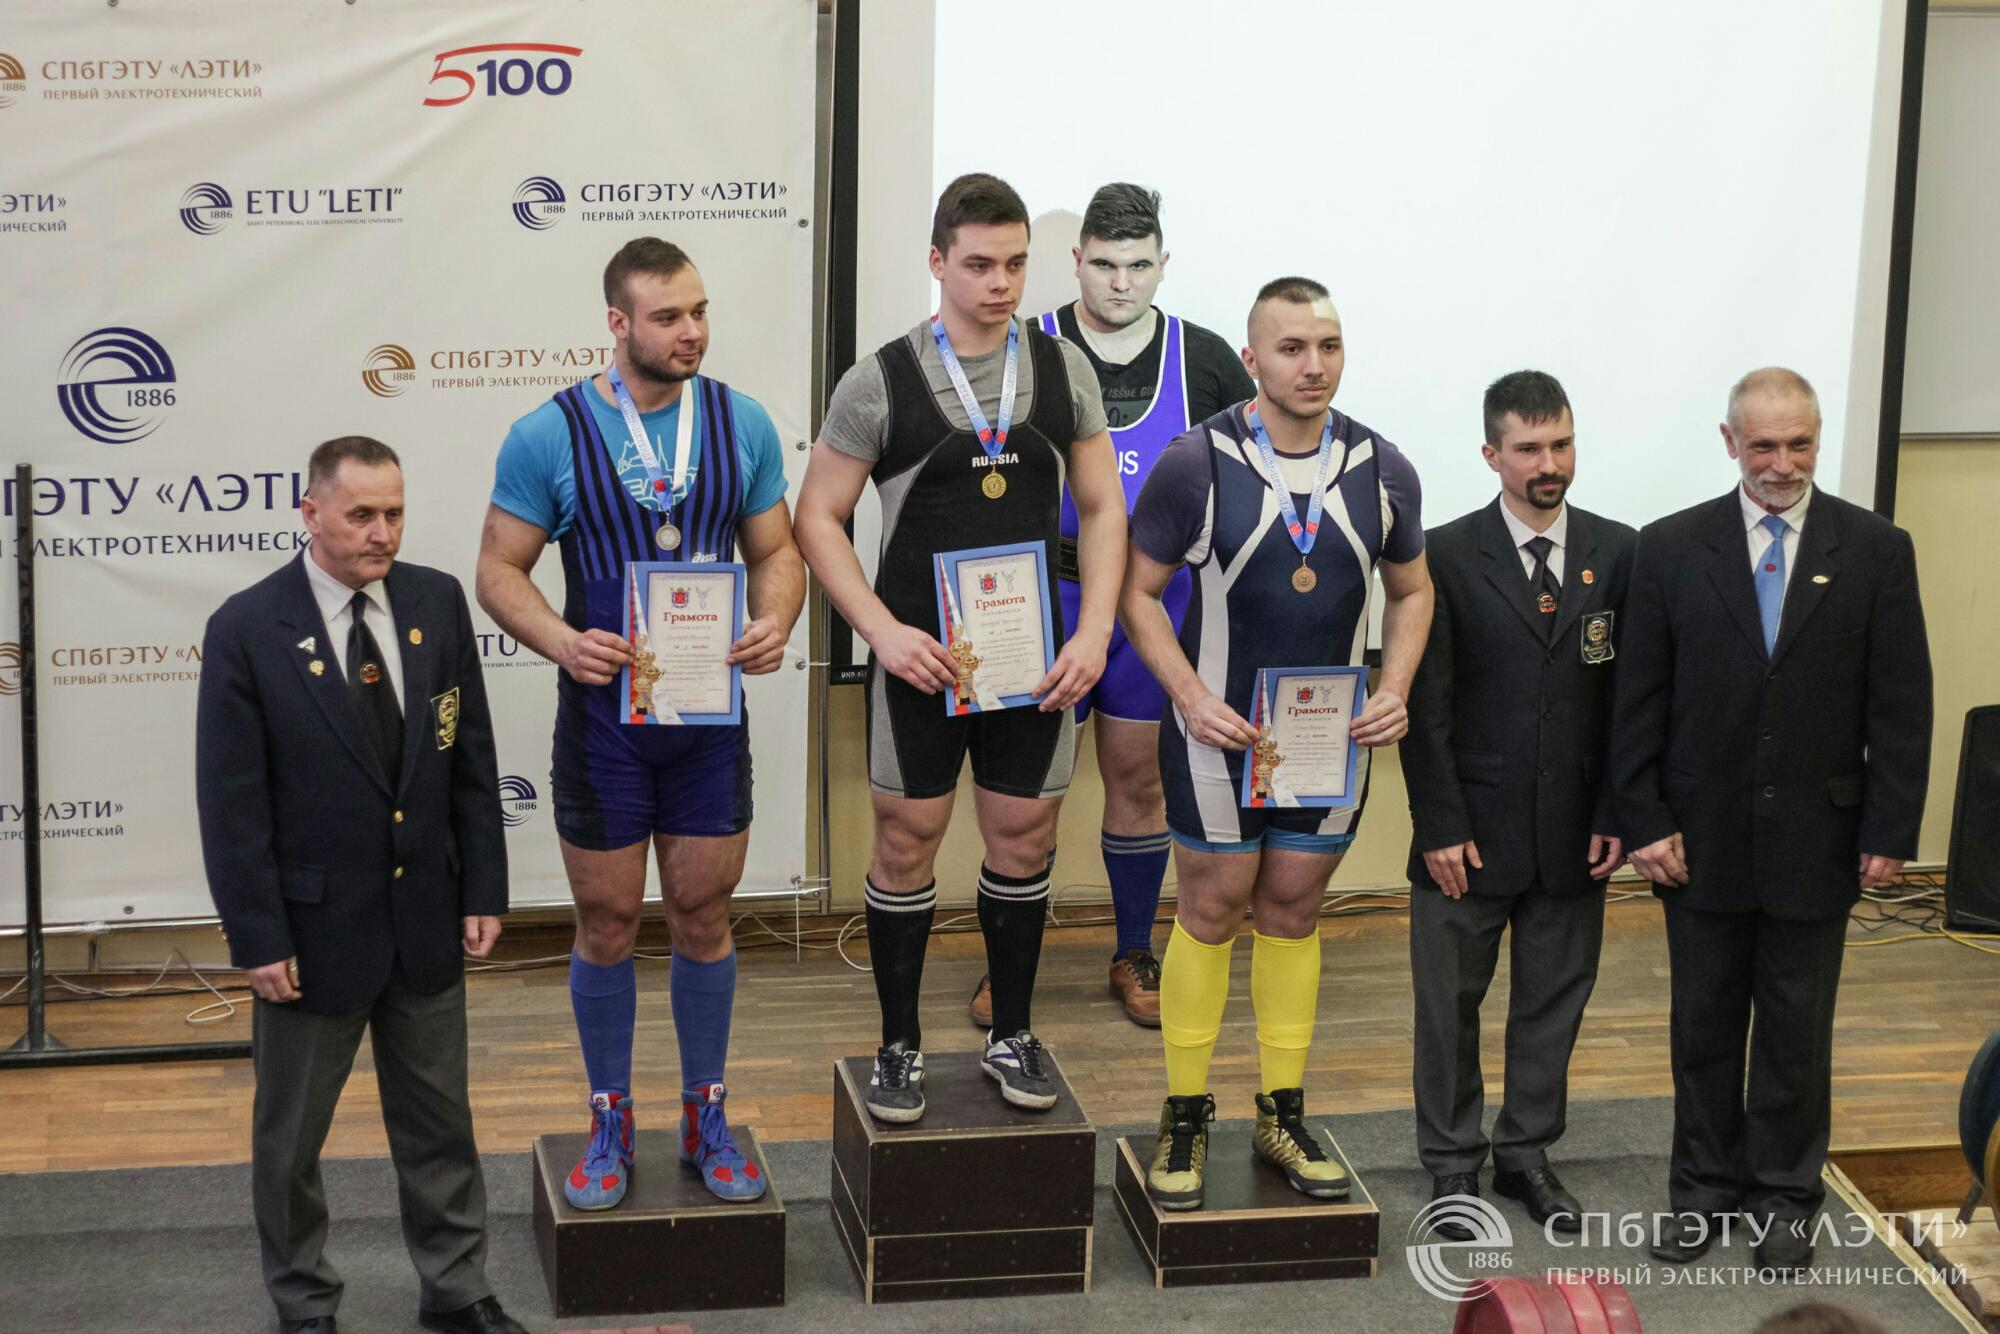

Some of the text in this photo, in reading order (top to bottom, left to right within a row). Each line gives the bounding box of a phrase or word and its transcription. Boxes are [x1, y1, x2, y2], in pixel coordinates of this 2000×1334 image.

[42, 60, 261, 80] СПбГЭТУ «ЛЭТИ»
[2, 82, 26, 91] 1886
[44, 87, 261, 99] ПЕРВЫЙ ЭЛЕКТРОТЕХНИЧЕСКИЙ
[581, 182, 786, 202] СПбГЭТУ «ЛЭТИ»
[0, 194, 66, 213] ЭТИ»
[247, 190, 308, 214] ETU
[209, 210, 234, 219] 1886
[542, 205, 566, 214] 1886
[583, 207, 786, 221] ПЕРВЫЙ ЭЛЕКТРОТЕХНИЧЕСКИЙ
[0, 220, 67, 232] ИЧЕСКИЙ
[431, 347, 616, 369] СПбГЭТУ «ЛЭТ
[392, 372, 416, 382] 1886
[433, 375, 587, 388] ПЕРВЫЙ ЭЛЕКТРОТЕХН
[126, 388, 177, 408] 1886
[13, 530, 311, 557] ЛЕКТРОТЕХНИЧЕСК
[975, 596, 1026, 610] Грамота
[663, 611, 718, 624] Грамота
[476, 633, 518, 657] TU
[52, 646, 168, 667] СПбГЭТУ
[54, 673, 106, 685] ПЕРВЫЙ
[1287, 706, 1338, 717] Грамота
[39, 800, 123, 821] ЛЭТИ»
[515, 801, 537, 811] 1886
